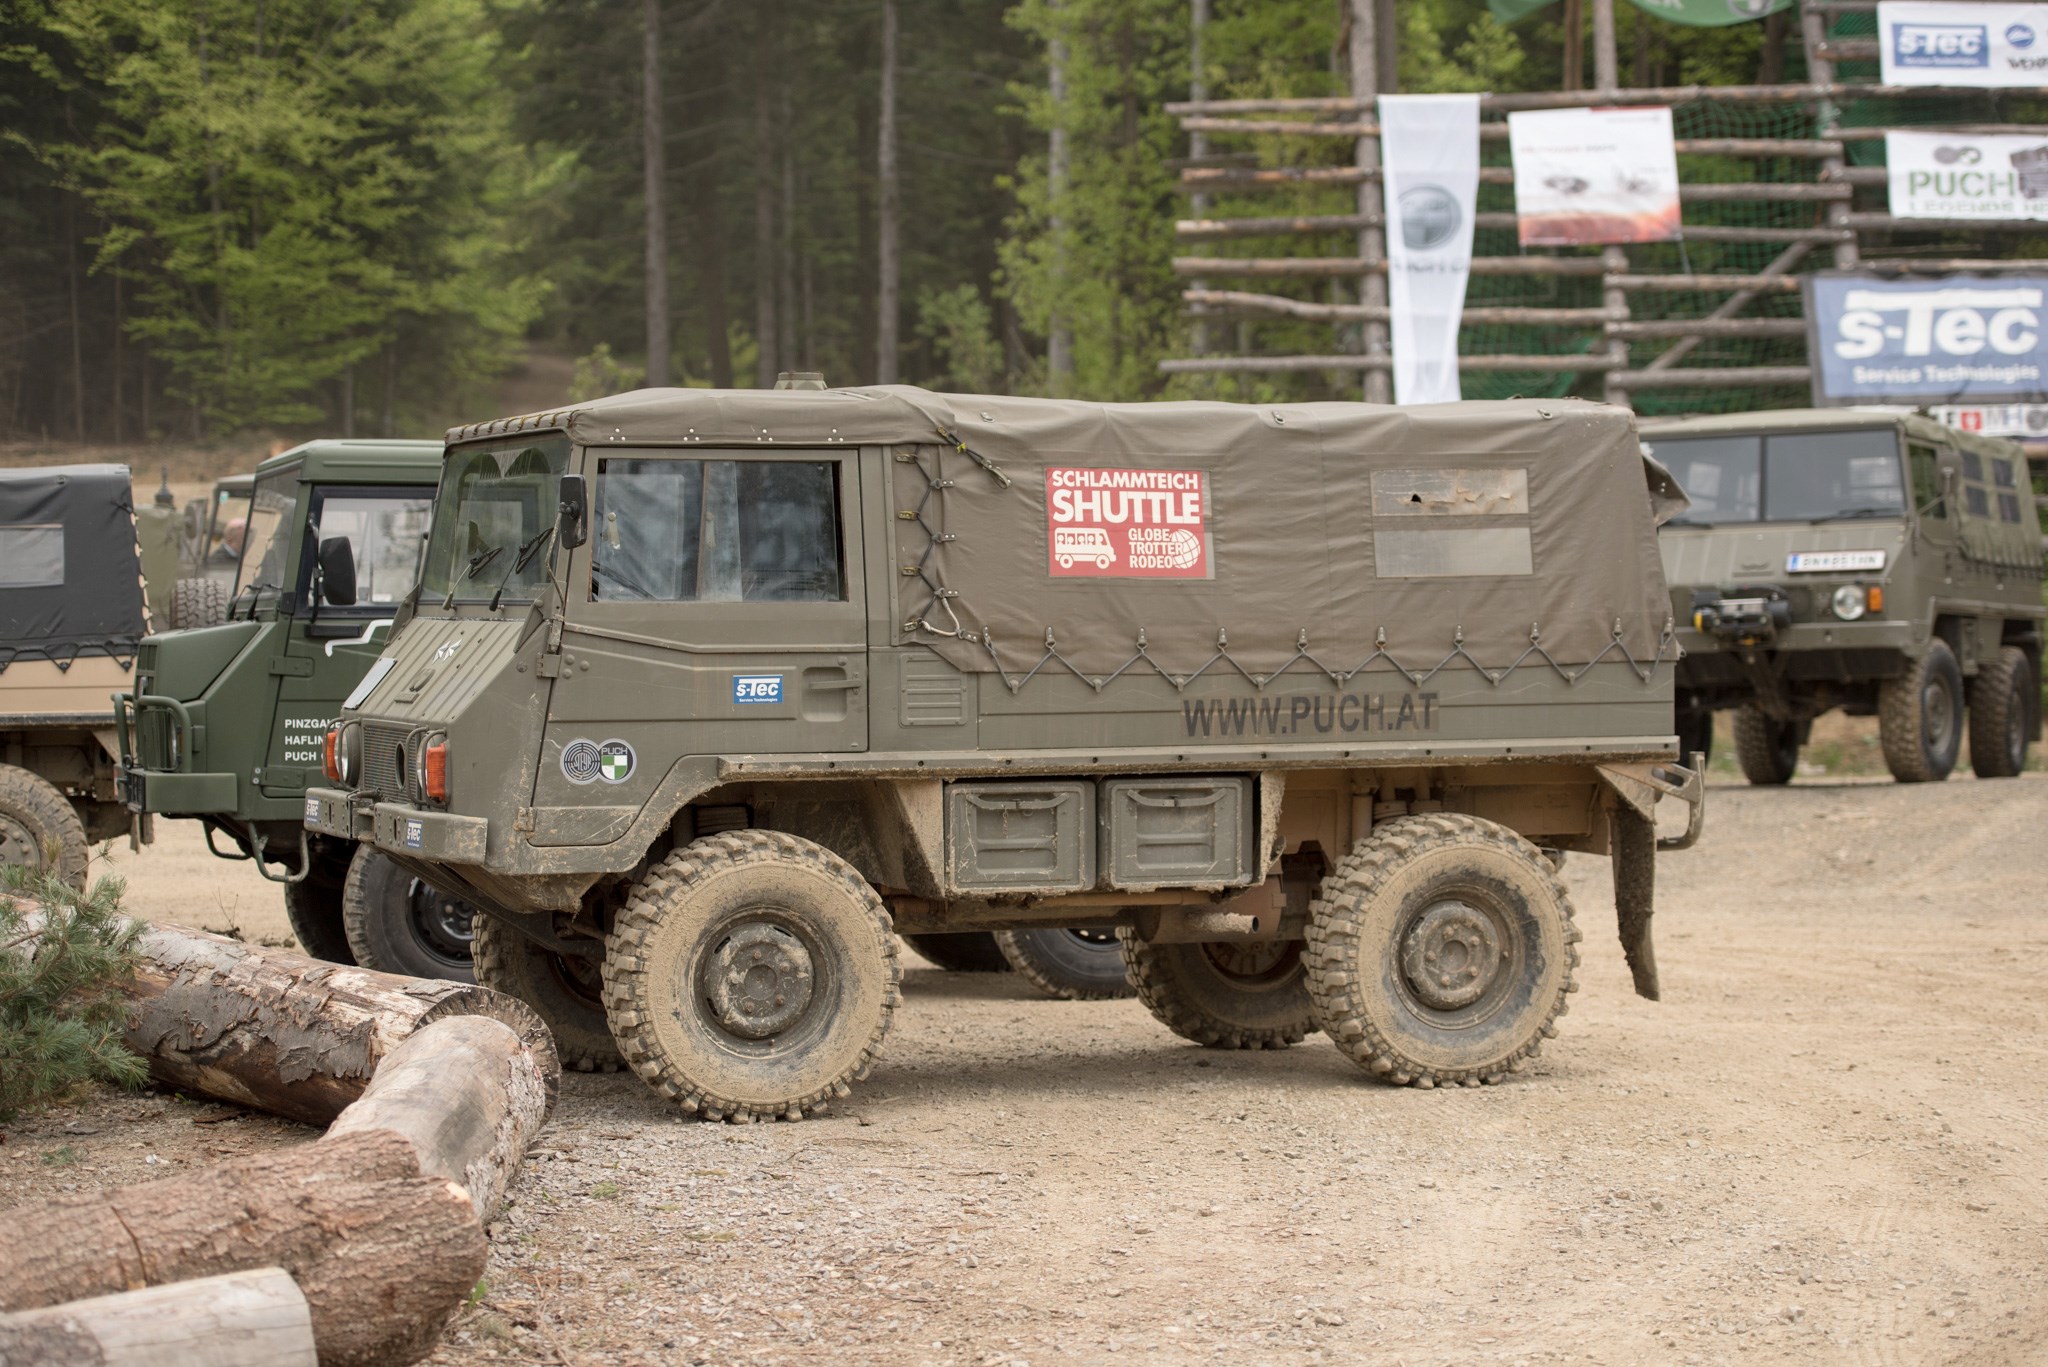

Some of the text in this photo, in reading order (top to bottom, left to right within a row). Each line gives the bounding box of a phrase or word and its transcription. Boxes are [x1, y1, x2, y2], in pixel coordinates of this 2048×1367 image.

[1898, 26, 1984, 55] s-Tec
[1909, 171, 2016, 197] PUCH
[1834, 288, 2043, 360] s-Tec
[1853, 363, 2040, 384] Service Technologies
[1052, 470, 1198, 489] SCHLAMMTEICH
[1053, 489, 1200, 524] SHUTTLE
[1128, 528, 1171, 542] GLOBE
[1129, 542, 1184, 555] TROTTER
[1130, 555, 1173, 568] RODEO
[736, 678, 780, 697] s-Tec
[1184, 692, 1438, 737] WWW.PUCH.AT
[285, 752, 317, 761] PUCH
[602, 747, 628, 755] PUCH
